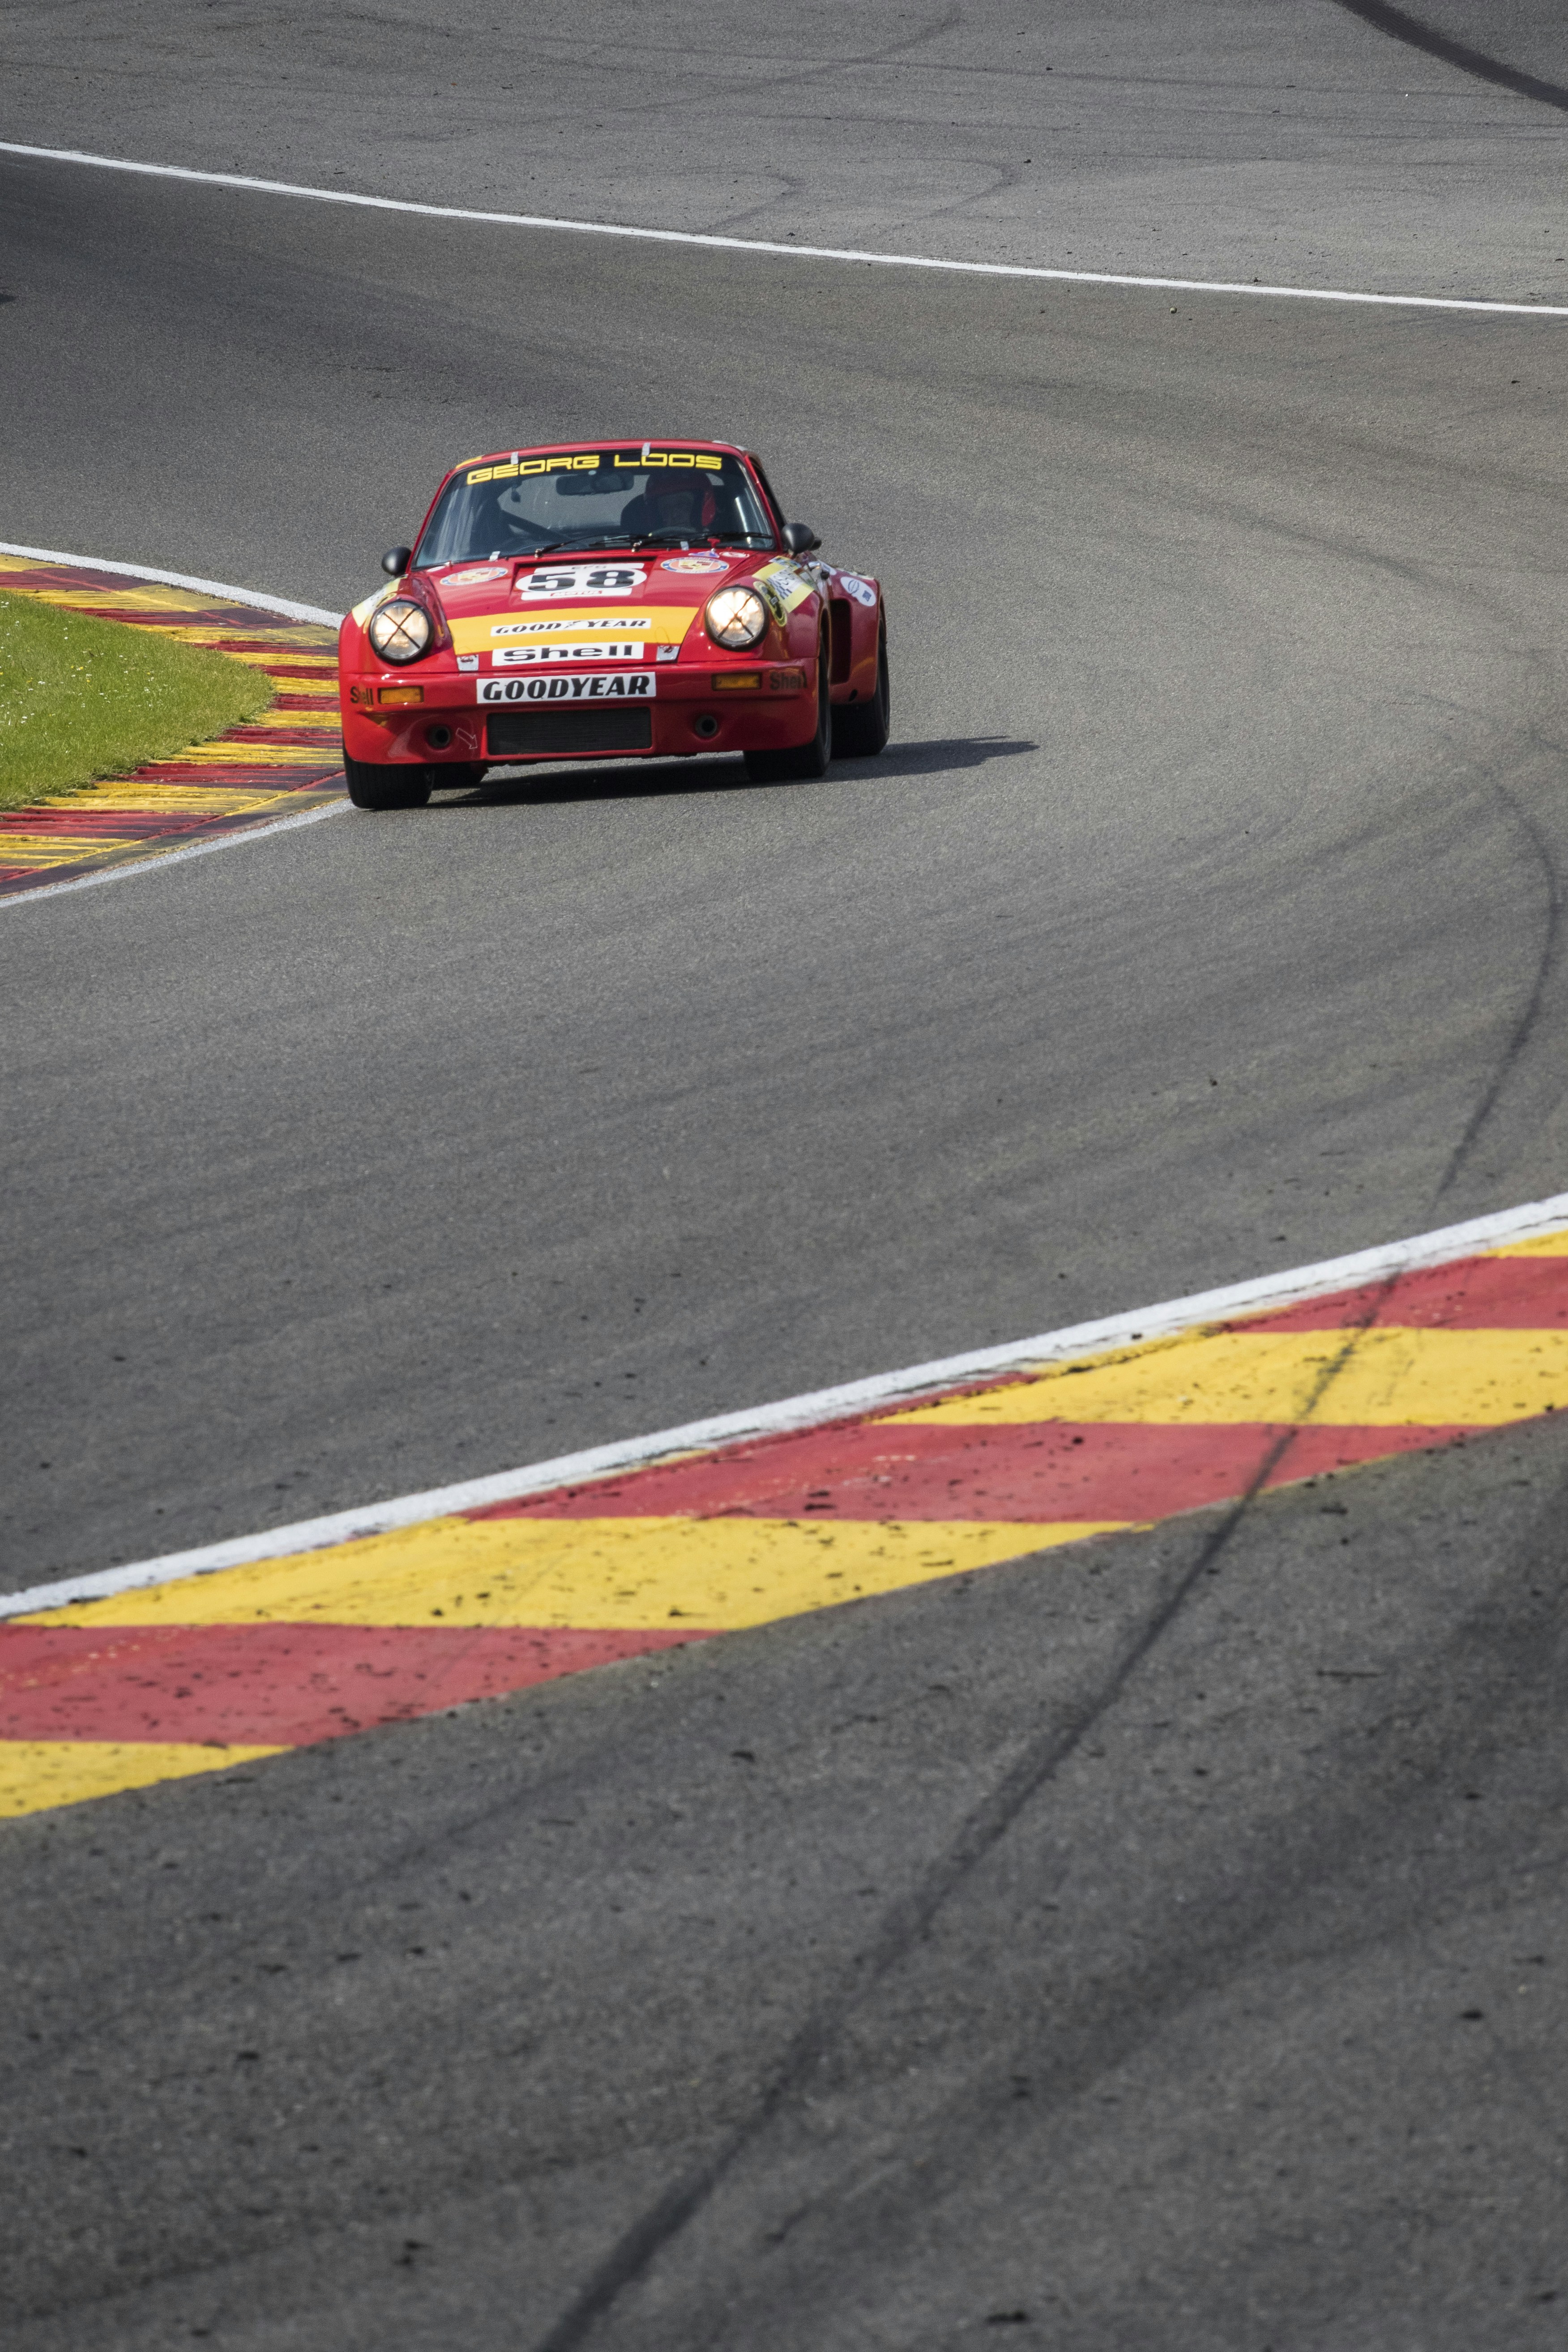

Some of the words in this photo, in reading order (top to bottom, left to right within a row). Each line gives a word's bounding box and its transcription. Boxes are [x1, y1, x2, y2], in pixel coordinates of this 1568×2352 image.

[467, 455, 600, 485] GEORG
[614, 453, 722, 470] LOOS
[528, 570, 635, 591] 58
[496, 623, 561, 634] GOOD
[504, 645, 632, 662] Shell
[483, 675, 650, 701] GOODYEAR
